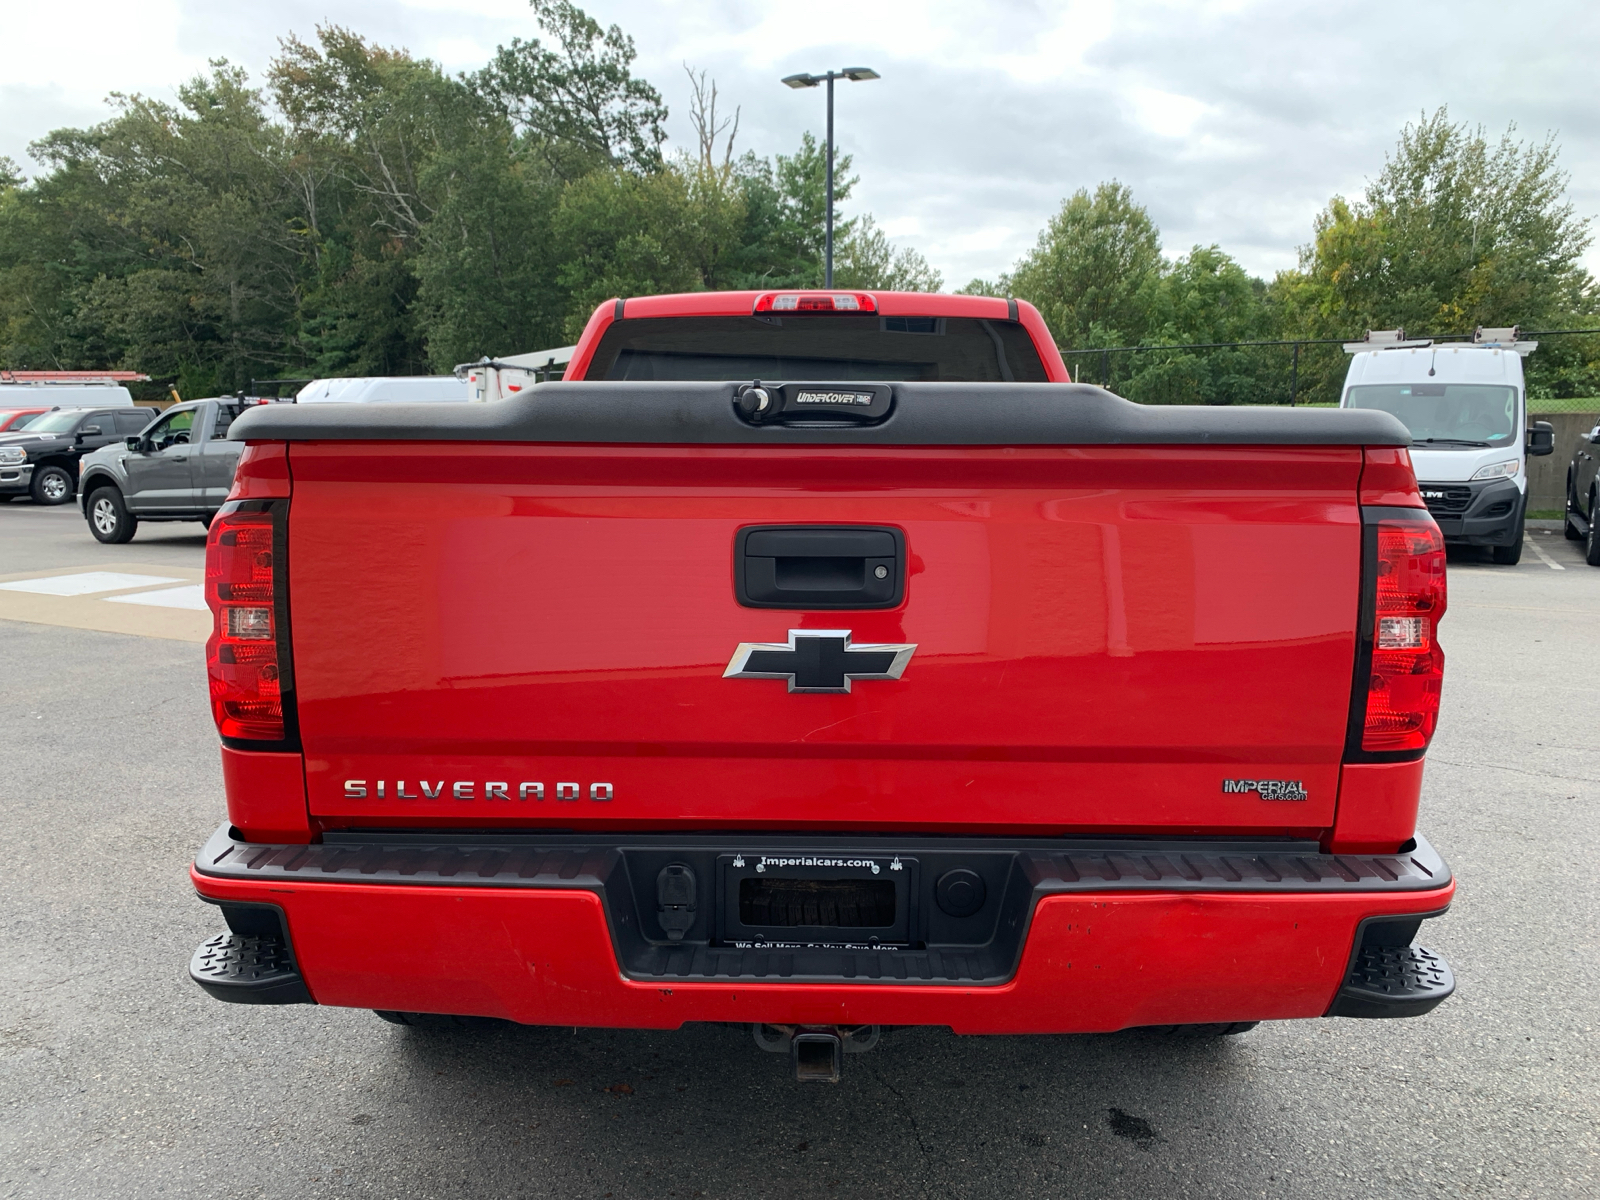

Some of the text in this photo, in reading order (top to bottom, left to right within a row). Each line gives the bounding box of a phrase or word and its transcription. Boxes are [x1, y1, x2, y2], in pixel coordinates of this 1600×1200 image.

[344, 780, 614, 800] SILVERADO
[1223, 780, 1307, 793] IMPERIAL
[1261, 792, 1308, 801] cars.com
[761, 856, 874, 867] Imperialcars.com
